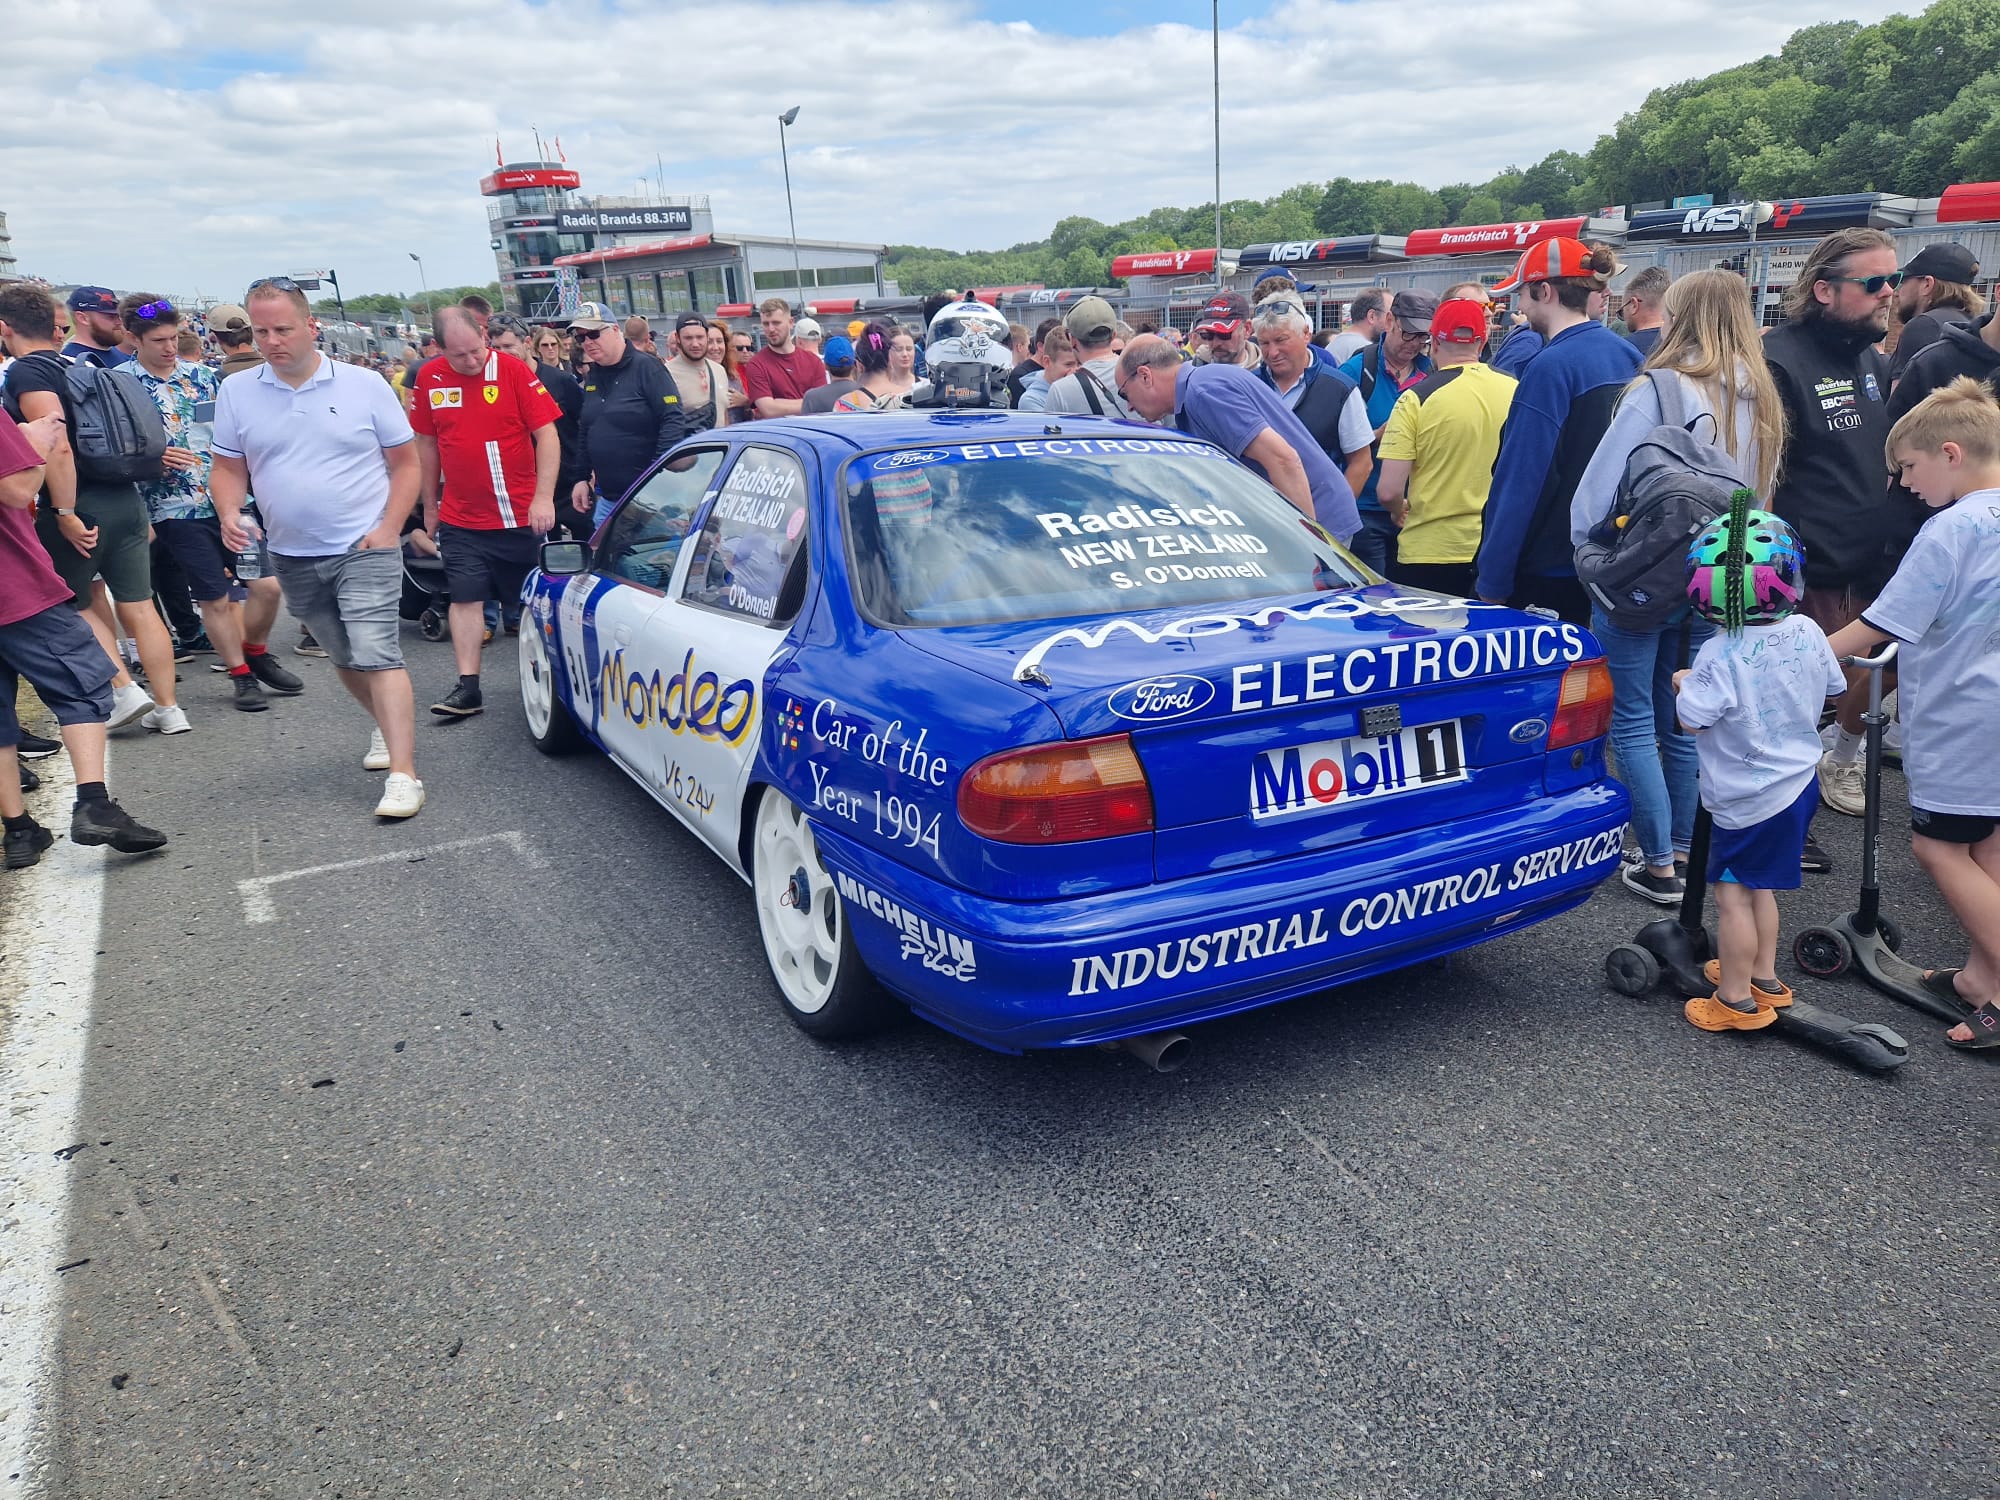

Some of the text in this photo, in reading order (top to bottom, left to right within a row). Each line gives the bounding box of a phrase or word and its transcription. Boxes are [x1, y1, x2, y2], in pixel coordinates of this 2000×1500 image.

[563, 211, 687, 228] Radio Brands 88.3FM
[1440, 229, 1508, 245] BrandsHatch
[1682, 208, 1750, 233] MS
[1132, 257, 1173, 269] BrandsHatch
[1269, 241, 1319, 262] MSV
[1029, 289, 1061, 303] MSV
[1820, 396, 1842, 410] EBC
[1826, 414, 1862, 431] icon
[892, 439, 1230, 467] Ford ELECTRONICS
[725, 462, 796, 500] Radisich
[713, 492, 786, 529] NEW ZEALAND
[1035, 503, 1246, 538] Radisich
[1059, 533, 1268, 569] NEW ZEALAND
[1110, 561, 1267, 590] S. O'Donnell
[729, 584, 778, 619] O'Donnell
[1130, 624, 1584, 715] Ford ELECTRONICS
[601, 647, 758, 748] Mondeo
[811, 698, 947, 787] Car of the
[663, 754, 683, 800] V6
[1252, 735, 1406, 814] Mobil
[808, 759, 942, 860] Year 1994
[837, 870, 976, 968] MICHELIN
[1067, 821, 1630, 997] INDUSTRIAL CONTROL SERVICES
[900, 934, 977, 983] Pilot
